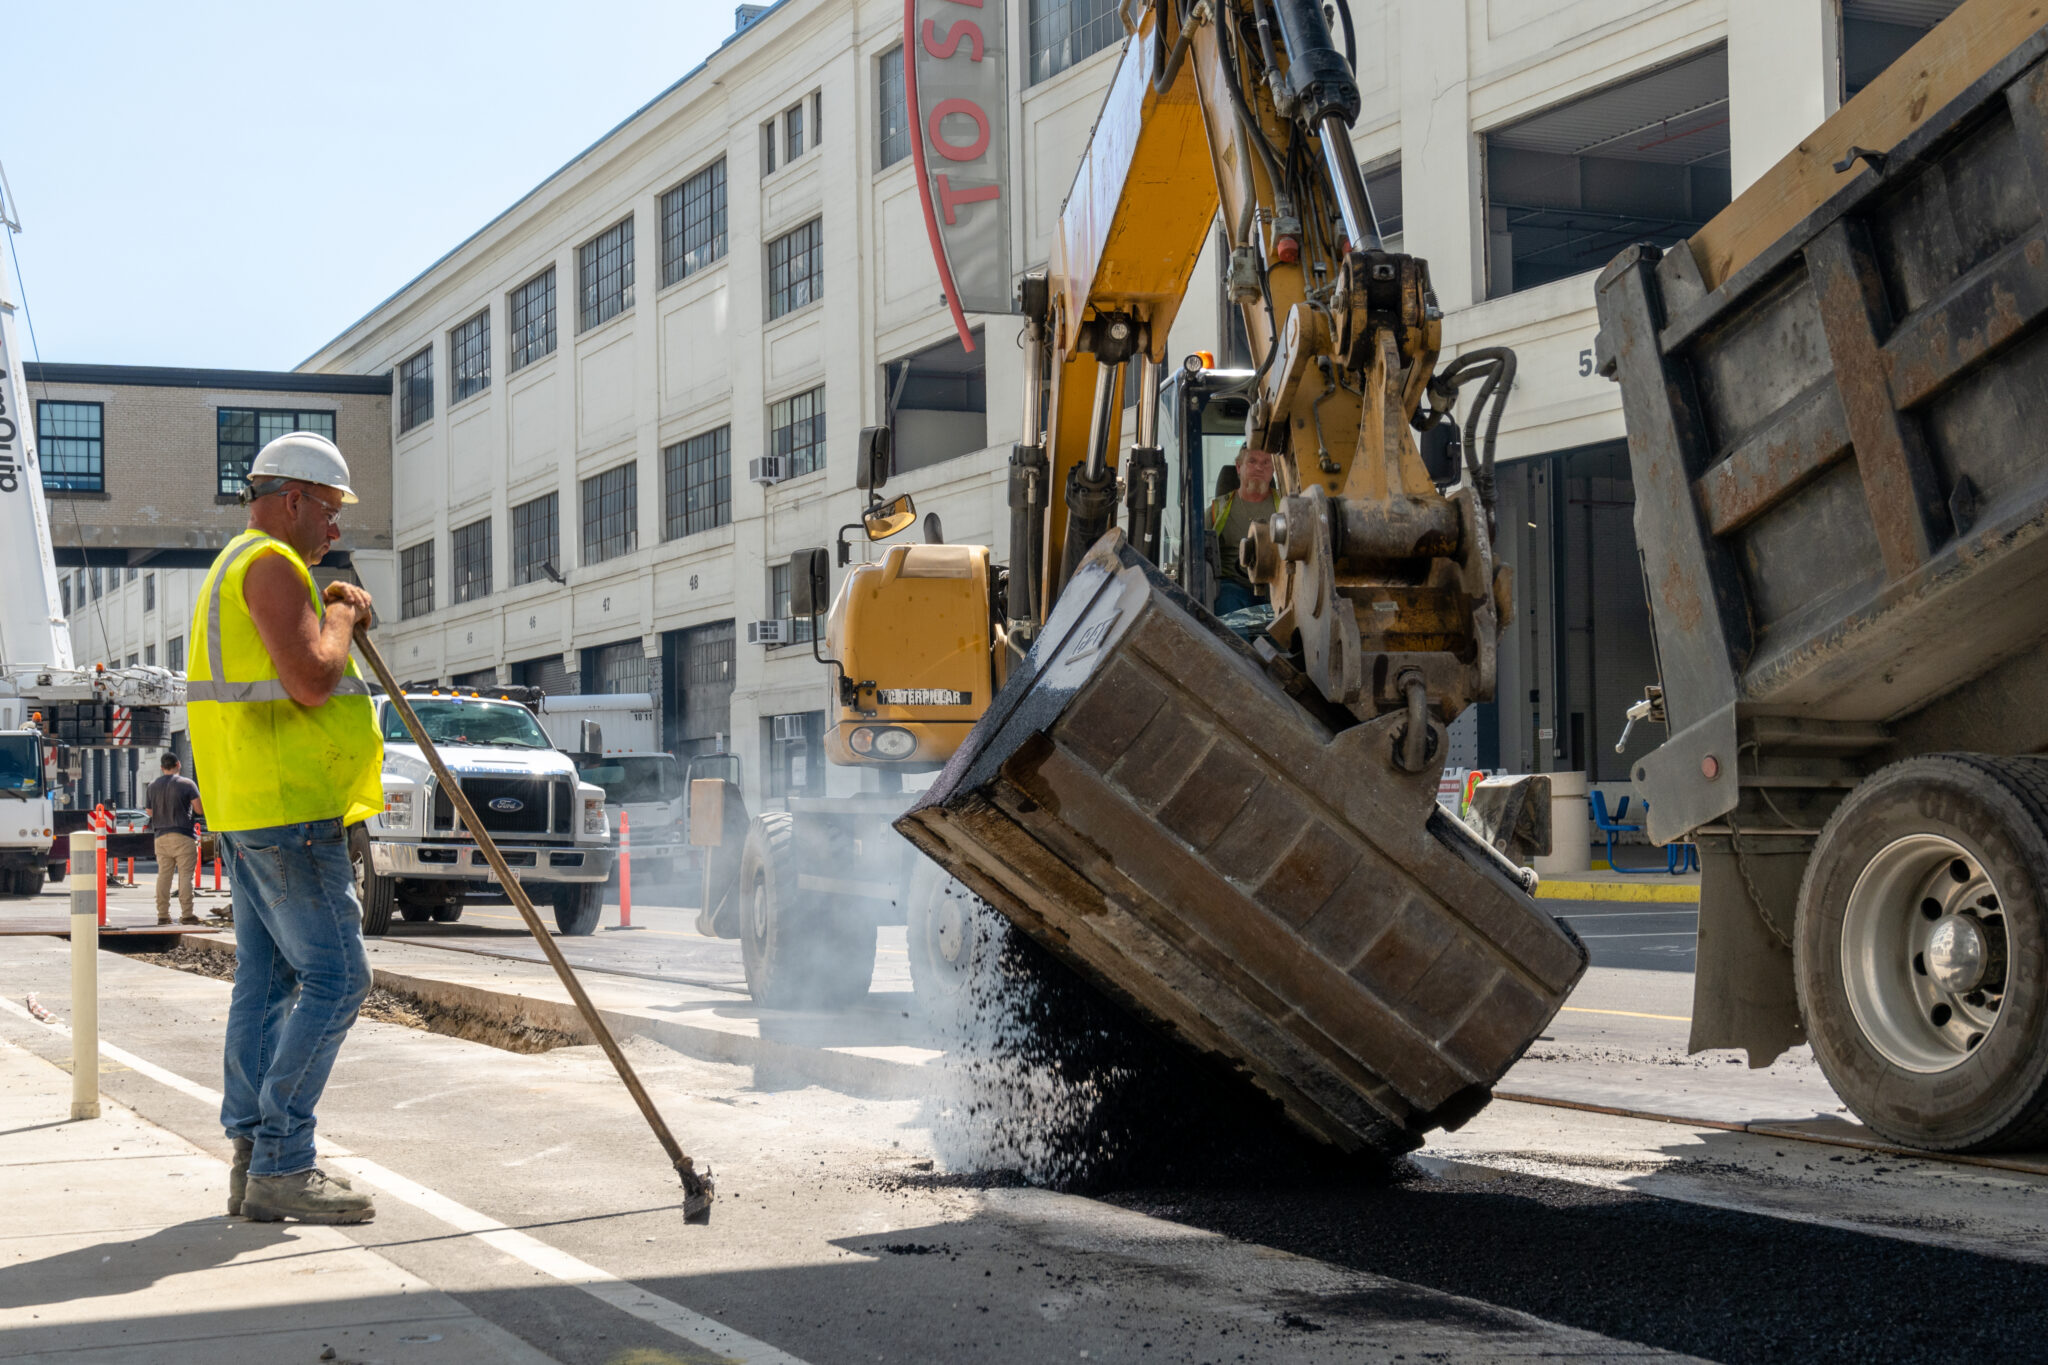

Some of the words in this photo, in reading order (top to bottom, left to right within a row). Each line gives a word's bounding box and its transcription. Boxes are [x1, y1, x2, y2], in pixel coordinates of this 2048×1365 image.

[922, 0, 984, 62] S
[1579, 349, 1599, 377] 5
[689, 574, 699, 591] 48
